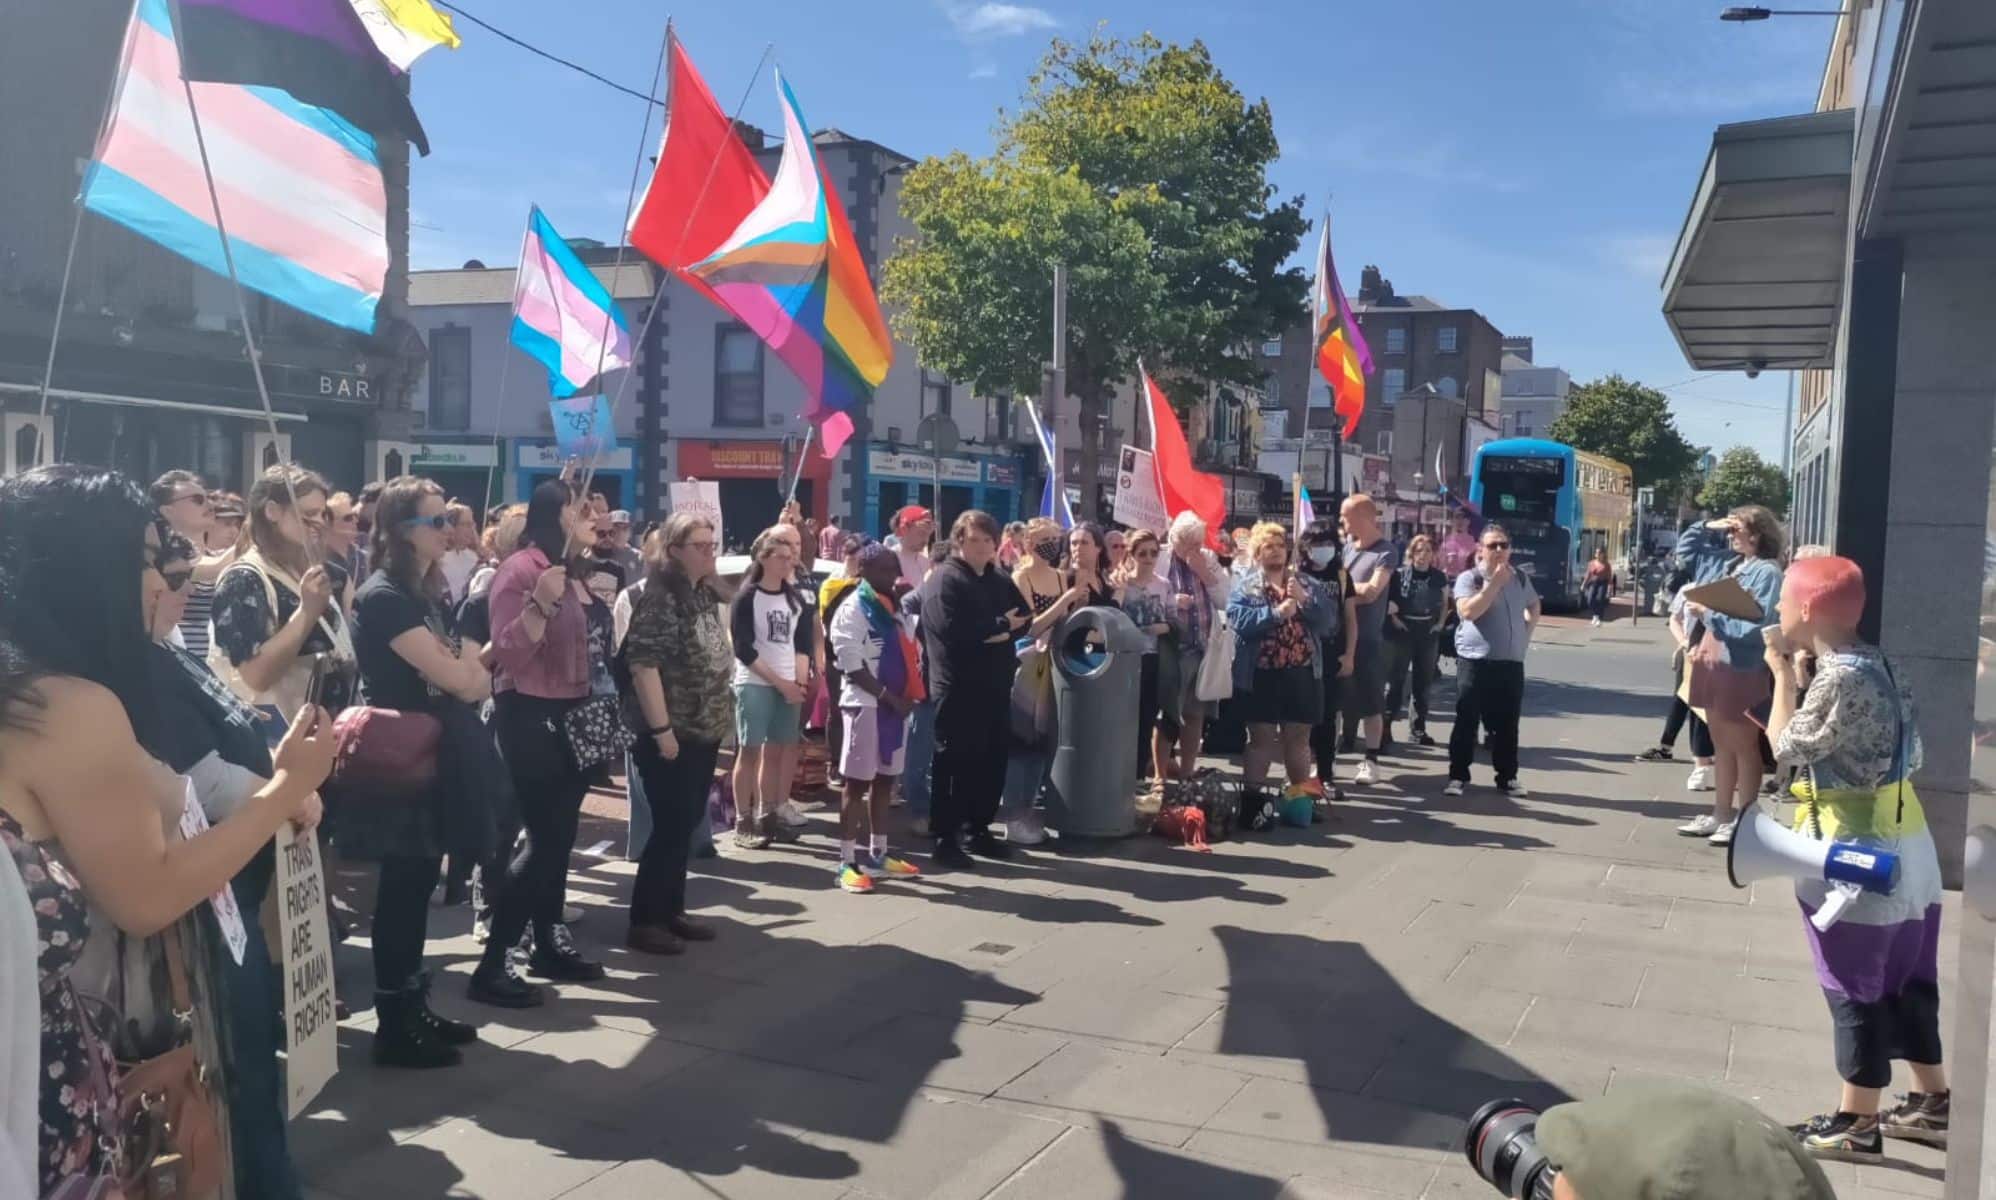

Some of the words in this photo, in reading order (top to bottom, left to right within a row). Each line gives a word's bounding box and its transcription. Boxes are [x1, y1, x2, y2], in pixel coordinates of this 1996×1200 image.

[320, 375, 369, 399] BAR
[284, 840, 313, 877] TRANS
[286, 873, 320, 920] RIGHTS
[291, 920, 313, 963] ARE
[292, 950, 329, 1004] HUMAN
[294, 988, 332, 1047] RIGHTS
